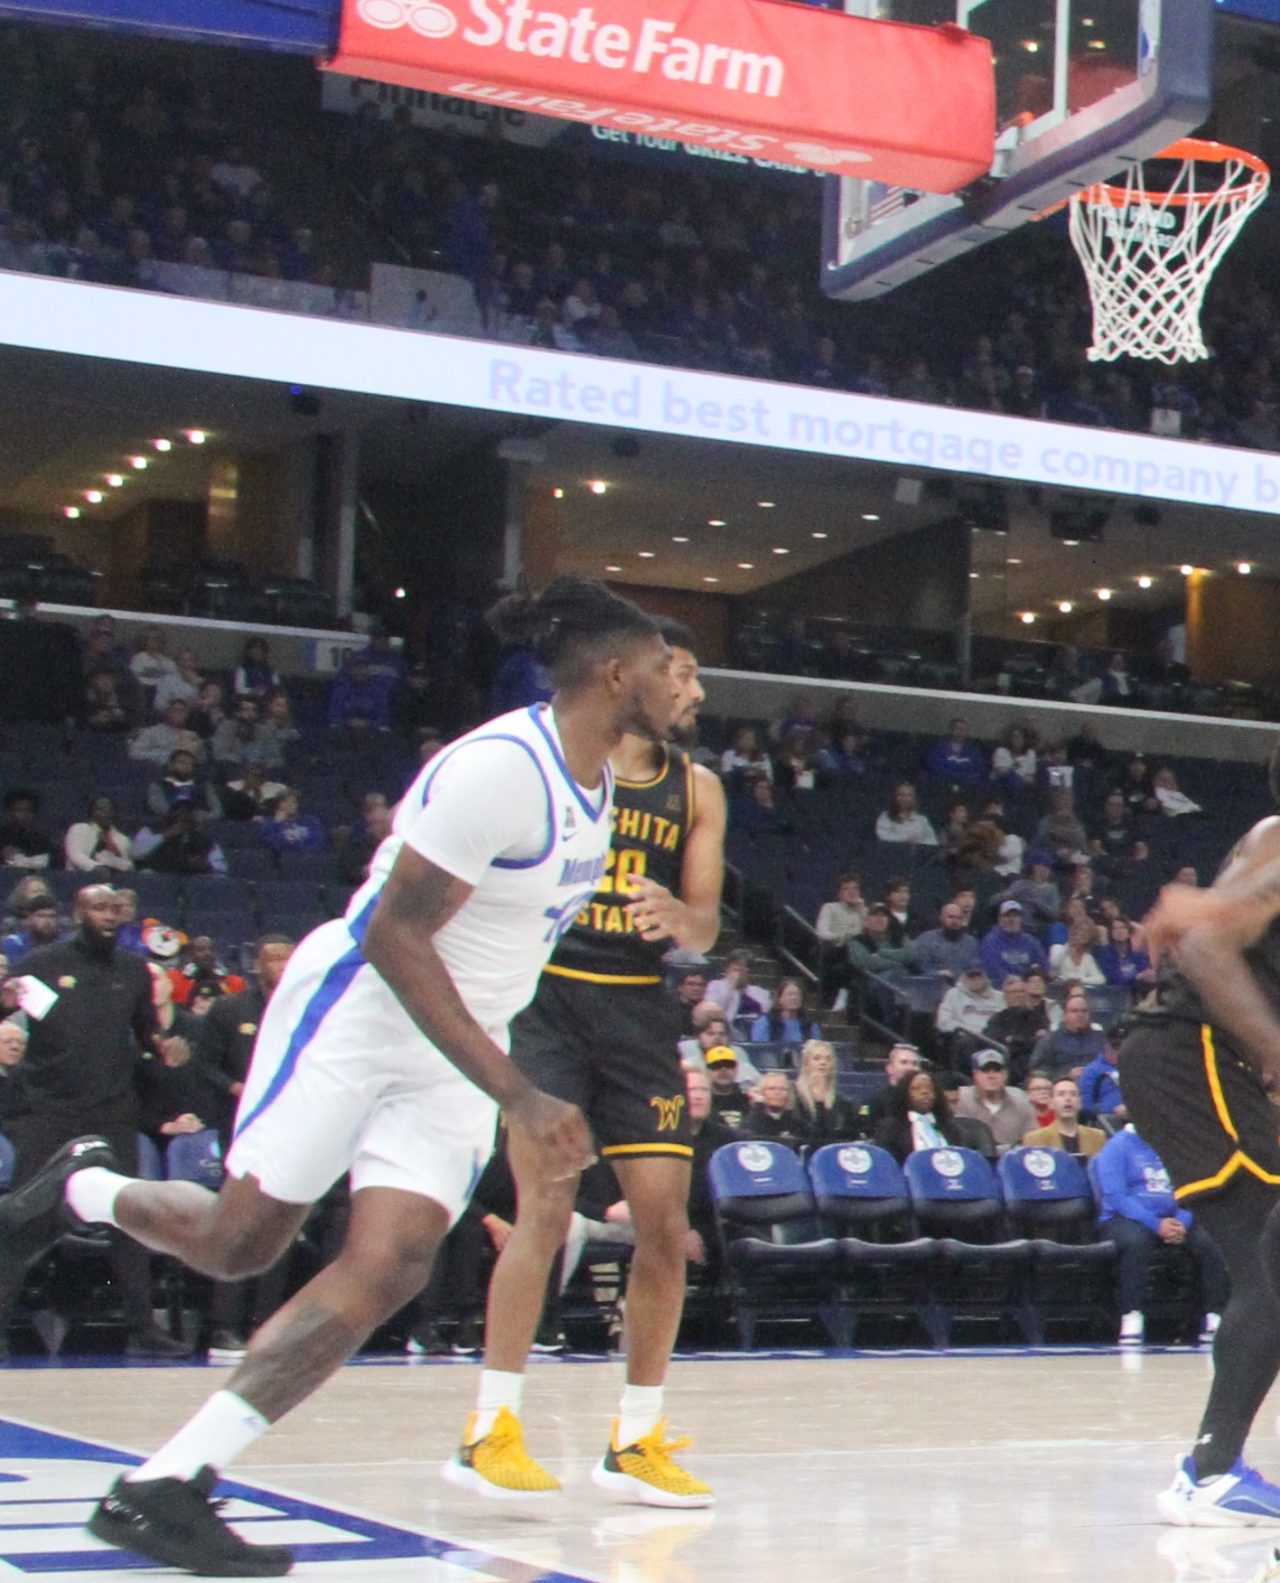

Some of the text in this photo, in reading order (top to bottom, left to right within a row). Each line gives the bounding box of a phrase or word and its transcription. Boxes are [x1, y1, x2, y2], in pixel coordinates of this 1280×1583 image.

[487, 358, 642, 420] Rated
[661, 379, 772, 437] best
[788, 409, 1023, 471] mortgage
[1040, 443, 1239, 503] company
